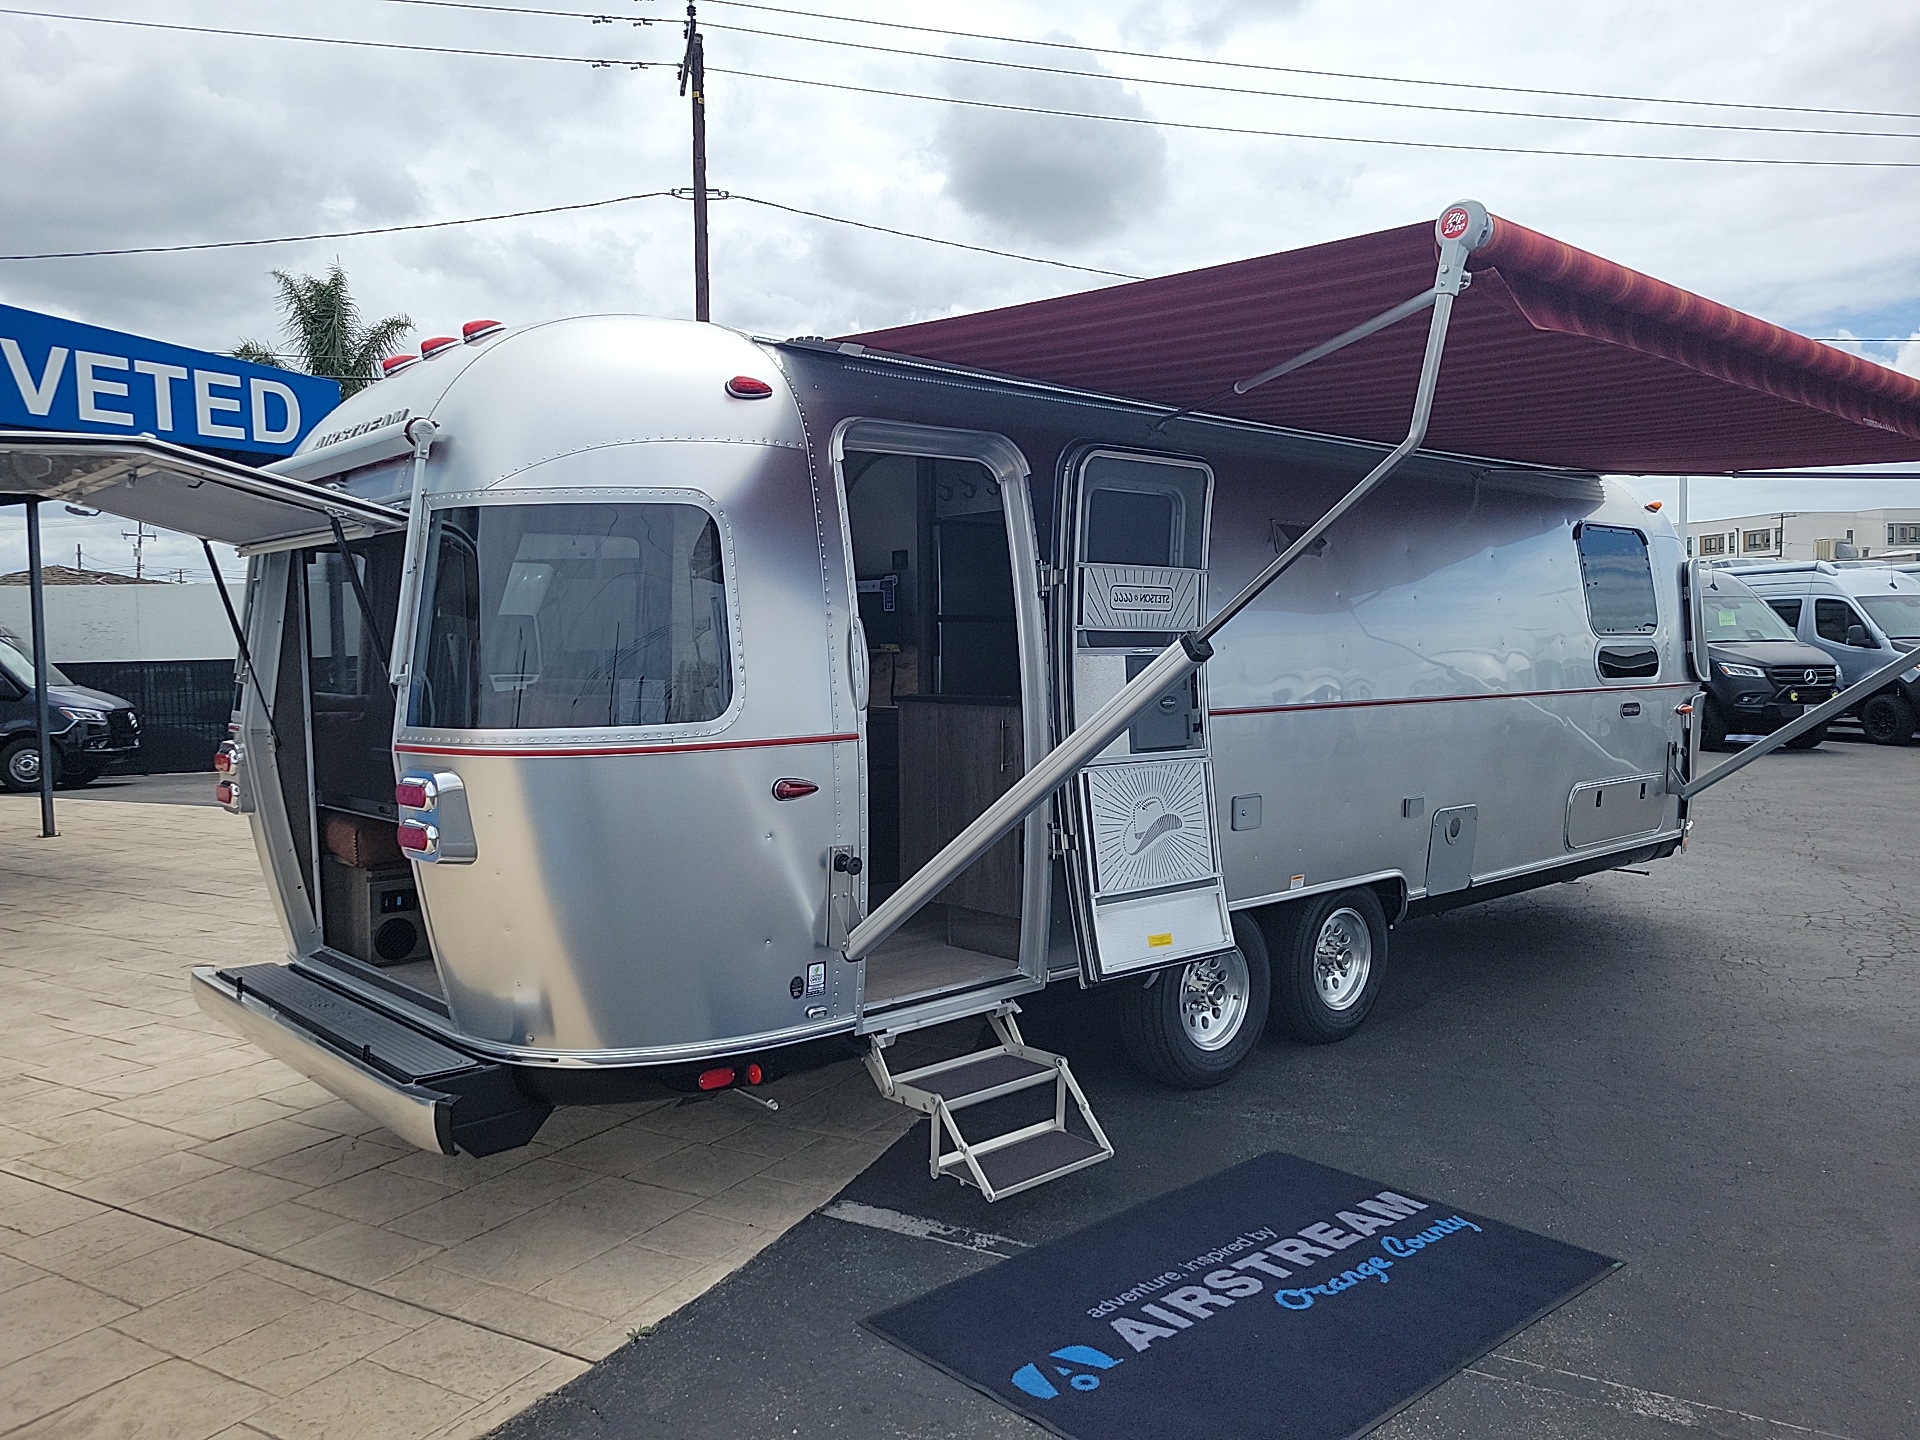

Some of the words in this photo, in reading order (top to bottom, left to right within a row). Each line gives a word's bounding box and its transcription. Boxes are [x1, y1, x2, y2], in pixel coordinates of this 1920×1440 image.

[0, 338, 301, 444] VETED
[1087, 1271, 1189, 1318] adventure,
[1178, 1233, 1254, 1272] inspired
[1245, 1226, 1278, 1241] by
[1109, 1191, 1430, 1352] AIRSTREAM
[1274, 1256, 1393, 1310] Orange
[1380, 1215, 1483, 1257] County
